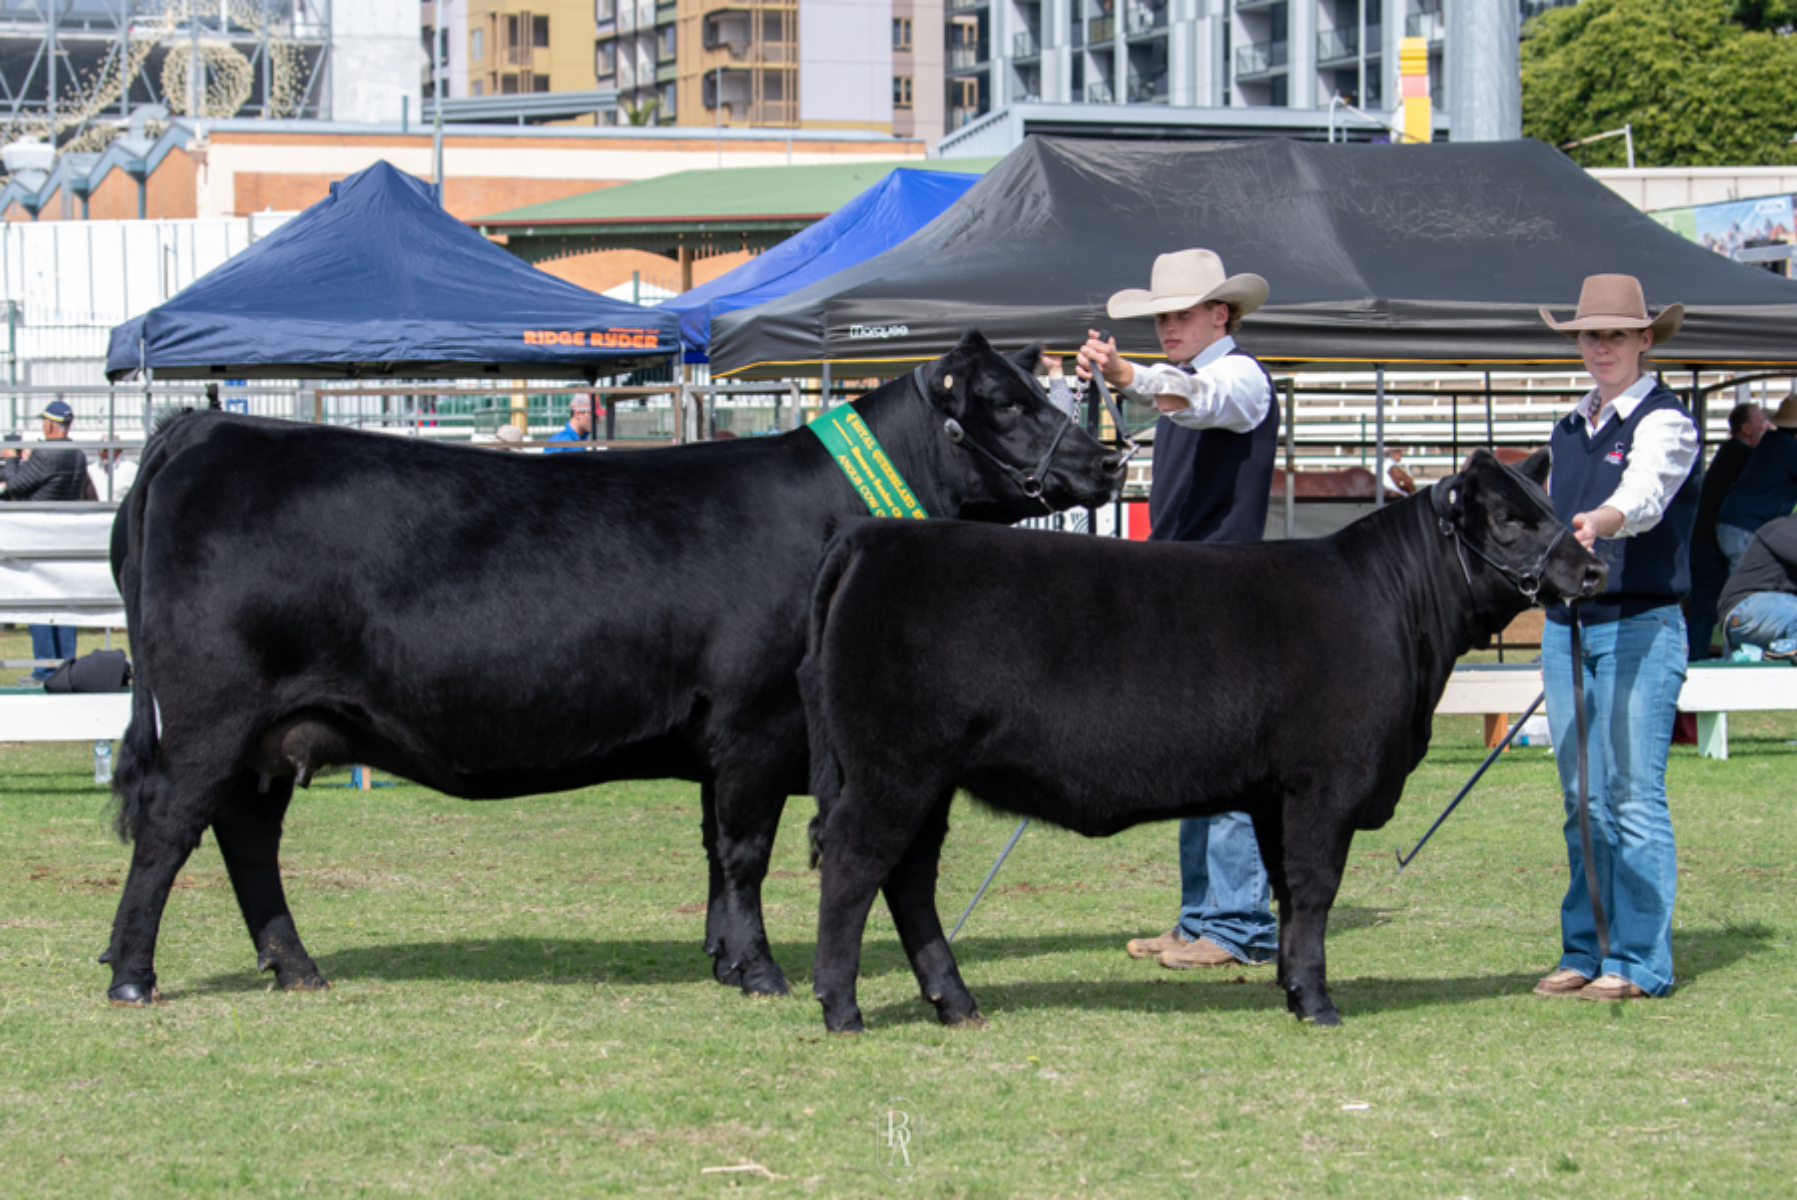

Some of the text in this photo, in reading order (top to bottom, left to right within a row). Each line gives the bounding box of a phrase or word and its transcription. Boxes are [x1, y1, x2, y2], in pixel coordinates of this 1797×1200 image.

[523, 330, 659, 349] RIDGE RYDER
[850, 324, 909, 339] Marquee
[836, 454, 879, 508] ANGUS COW
[851, 417, 916, 509] ROYAL QUEENSLAND
